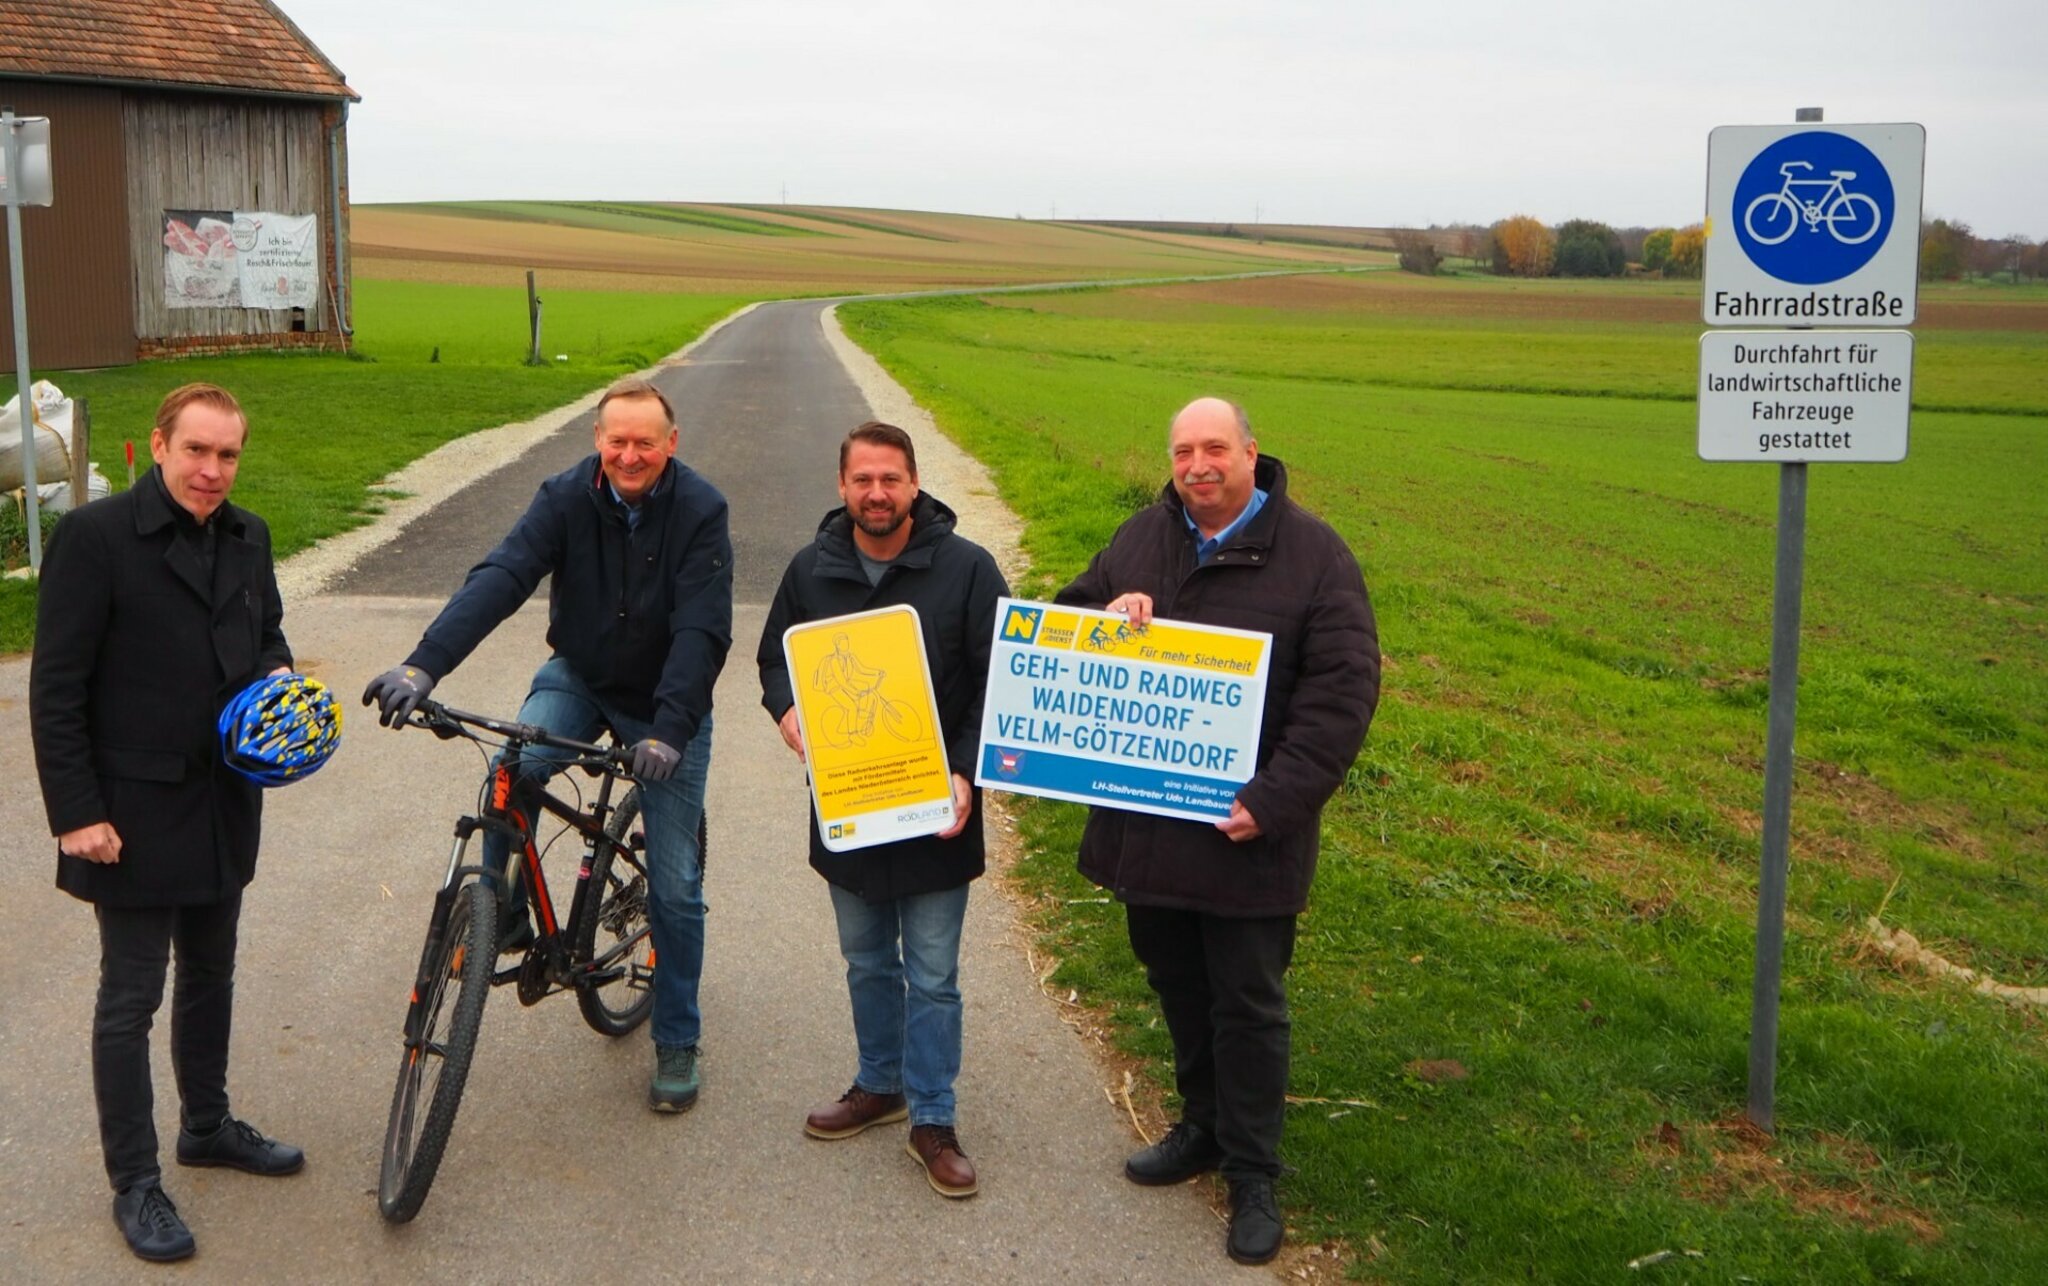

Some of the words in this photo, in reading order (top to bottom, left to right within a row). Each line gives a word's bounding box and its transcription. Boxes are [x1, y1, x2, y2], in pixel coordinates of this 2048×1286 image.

[1715, 290, 1903, 317] Fahrradstraße
[1734, 345, 1841, 364] Durchfahrt
[1849, 344, 1878, 364] für
[1708, 372, 1902, 392] landwirtschaftliche
[1752, 401, 1854, 425] Fahrzeuge
[1759, 432, 1852, 452] gestattet
[1042, 626, 1075, 637] STRASSEN
[1139, 646, 1158, 658] Für
[1161, 649, 1191, 664] mehr
[1194, 653, 1252, 672] Sicherheit
[1010, 652, 1069, 680] GEH-
[1079, 661, 1129, 690] UND
[1139, 671, 1242, 707] RADWEG
[1033, 686, 1194, 731] WAIDENDORF
[998, 713, 1239, 772] VELM-GÖTZENDORF
[1092, 780, 1164, 800] LH-Stellvertreter
[1165, 793, 1184, 803] Udo
[1163, 780, 1182, 790] eine
[1183, 782, 1218, 796] Initiative
[1219, 789, 1235, 798] von
